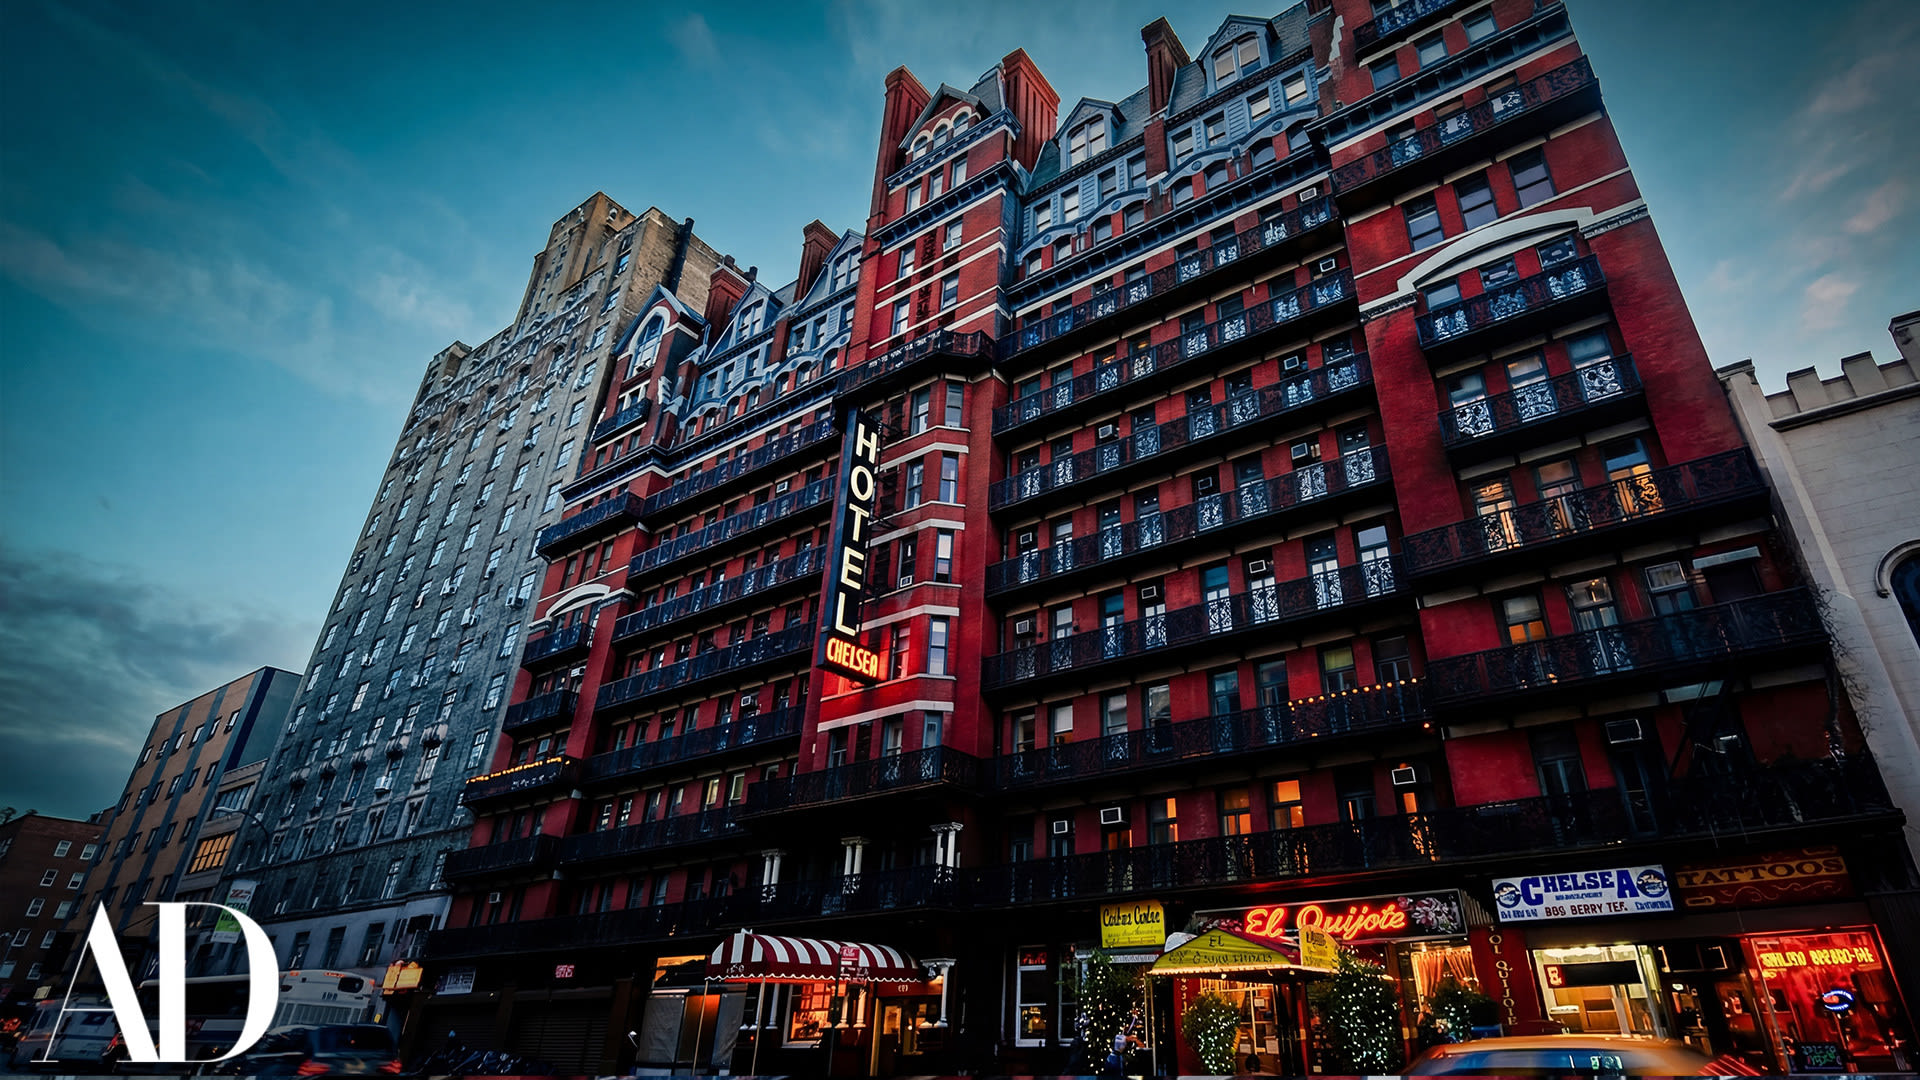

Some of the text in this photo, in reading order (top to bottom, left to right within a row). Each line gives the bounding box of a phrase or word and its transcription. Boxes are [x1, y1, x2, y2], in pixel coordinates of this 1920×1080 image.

[835, 423, 878, 637] HOTEL
[826, 637, 879, 678] CHELSEA
[1520, 869, 1640, 906] CHELSEA
[1680, 857, 1844, 886] TATTOOS
[1245, 908, 1285, 938] El
[1297, 903, 1406, 941] Quijote
[1570, 903, 1603, 915] BERRY
